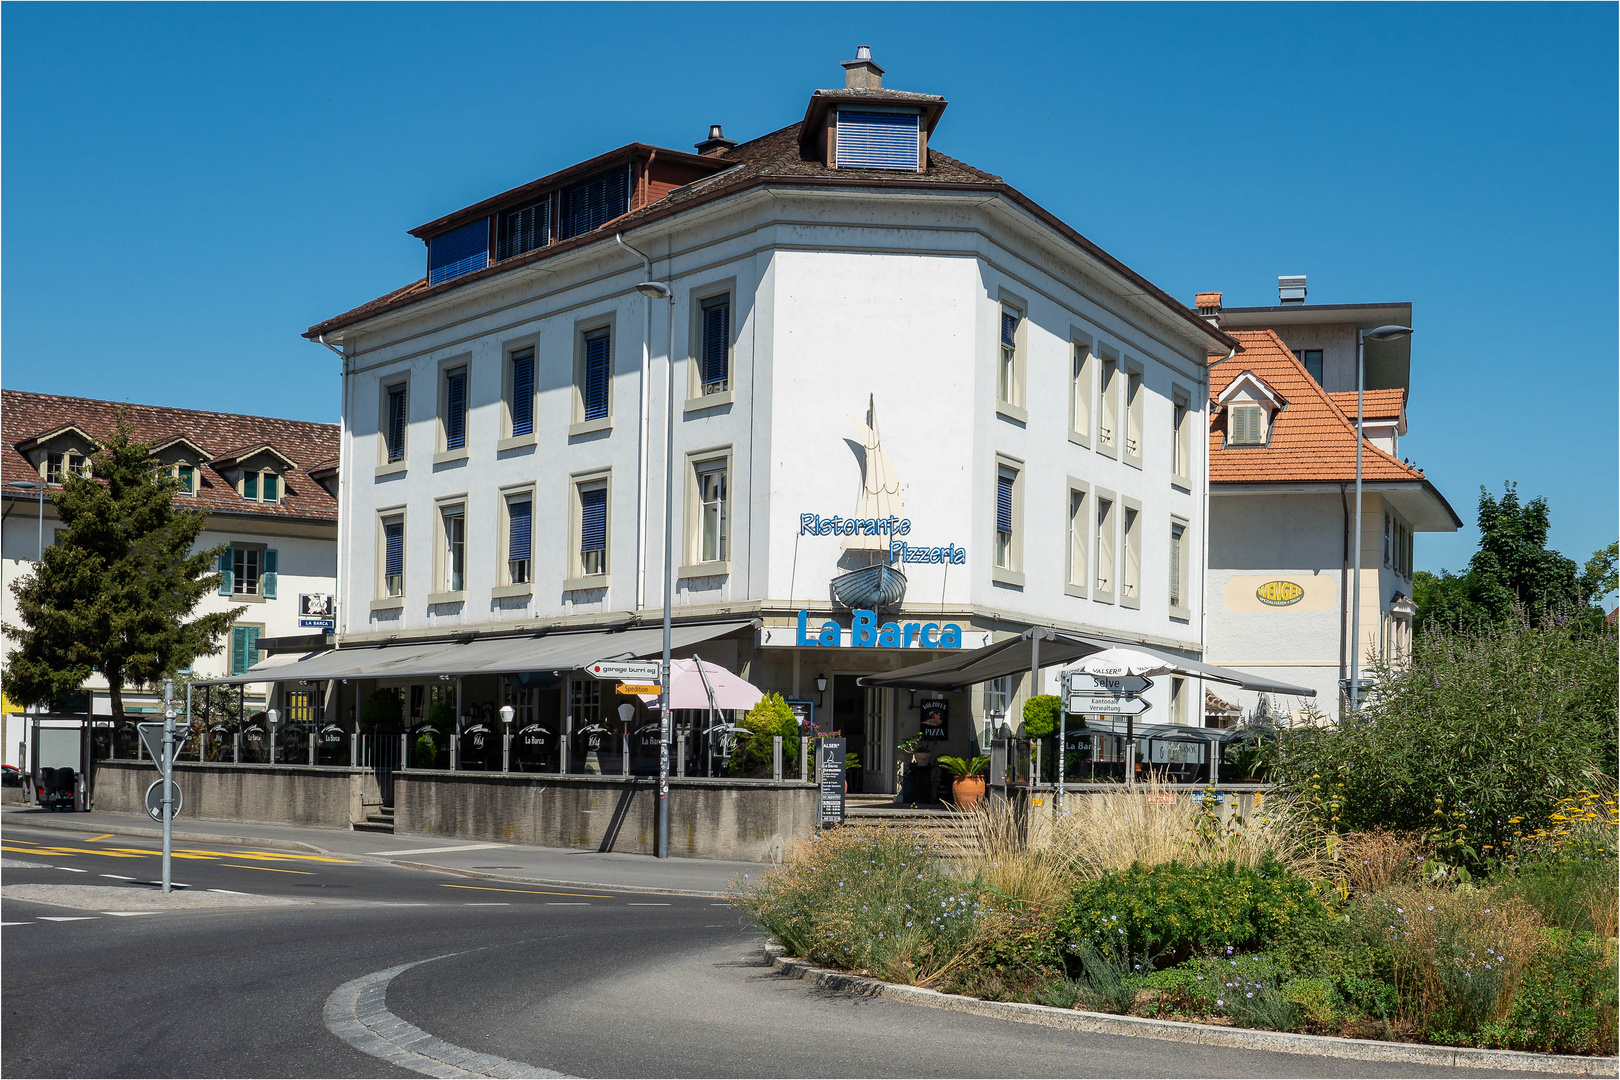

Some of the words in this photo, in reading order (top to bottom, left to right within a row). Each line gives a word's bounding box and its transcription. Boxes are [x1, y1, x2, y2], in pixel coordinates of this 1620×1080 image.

[800, 513, 911, 536] Ristorante
[889, 540, 966, 564] Pizzeria
[1257, 582, 1302, 600] WENGER
[797, 609, 841, 648] La
[852, 609, 962, 648] Barca
[1094, 678, 1120, 688] Selve
[925, 728, 945, 737] PIZZA
[525, 736, 531, 744] La
[532, 736, 545, 744] Barca
[641, 737, 648, 745] La
